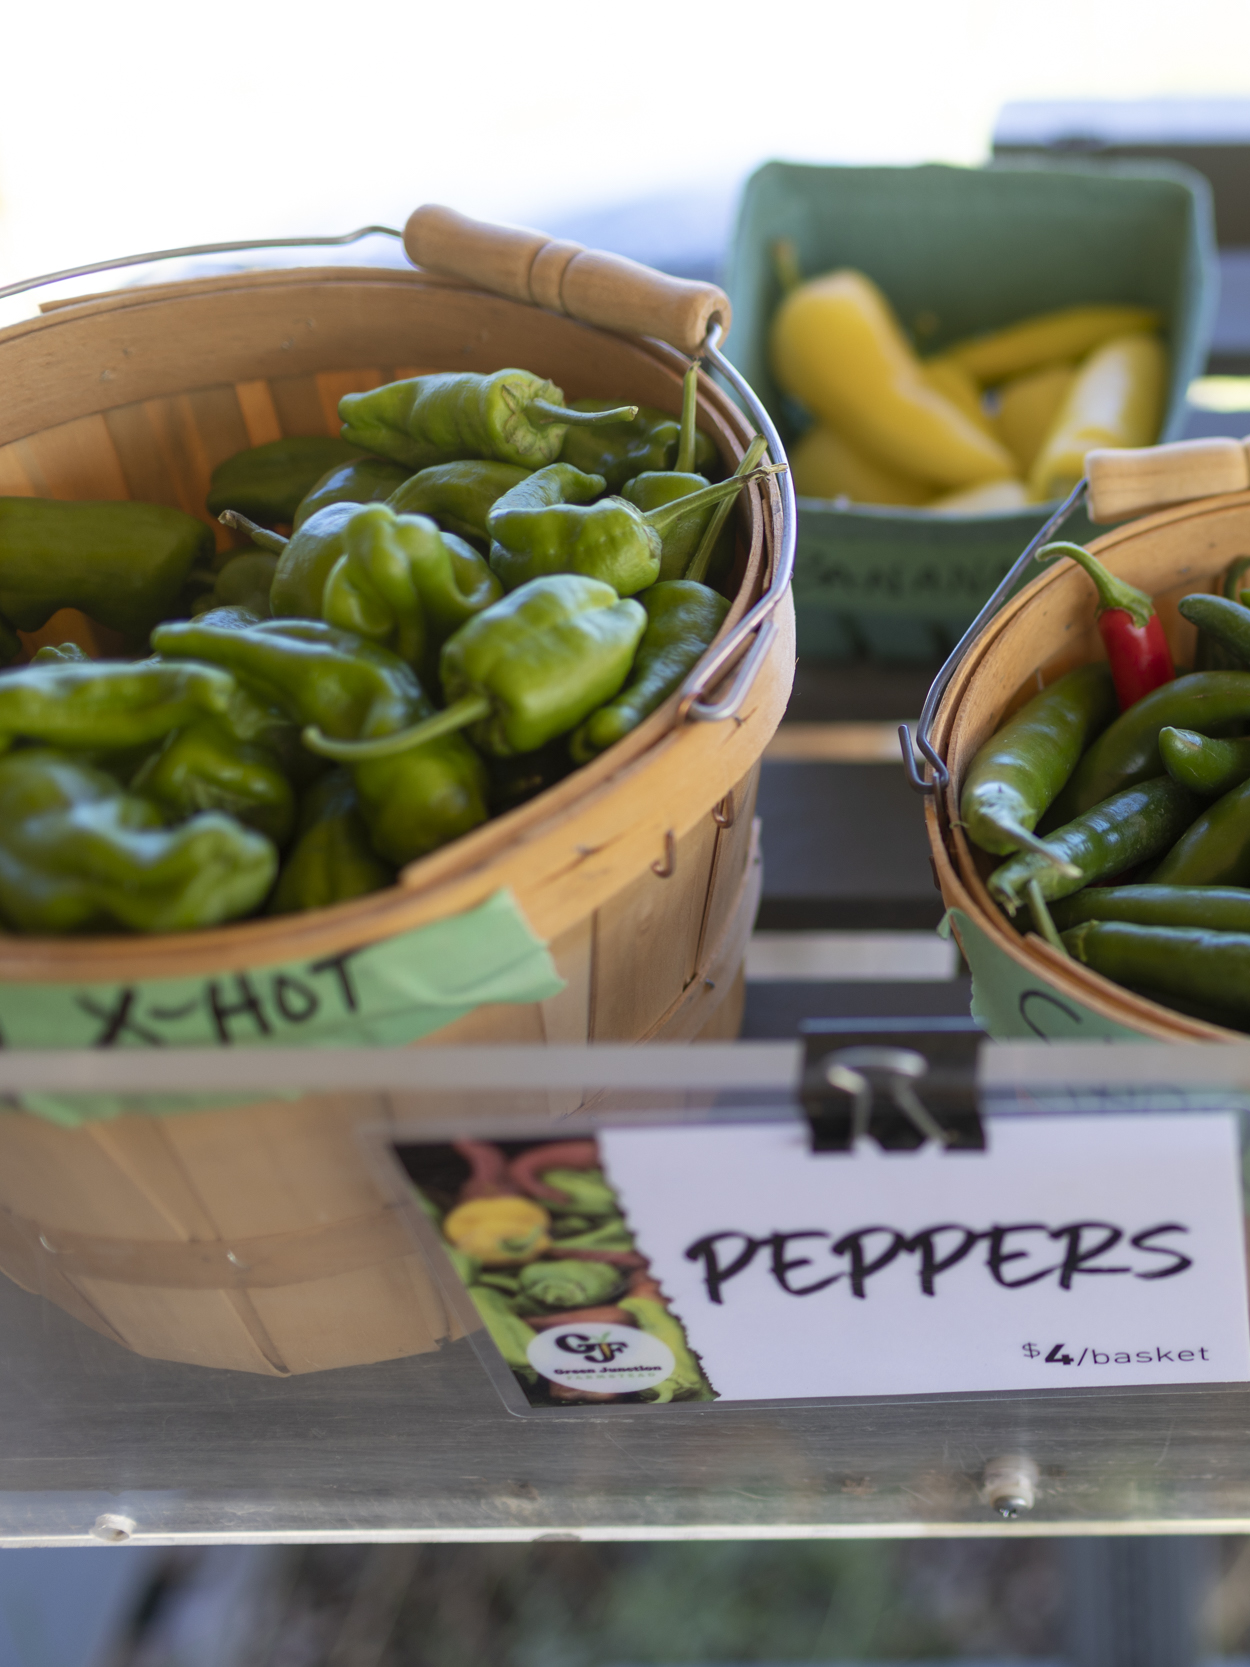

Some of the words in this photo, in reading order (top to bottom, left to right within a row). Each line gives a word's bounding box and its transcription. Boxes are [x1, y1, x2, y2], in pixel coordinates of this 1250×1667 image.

[73, 952, 358, 1048] X-HOT
[685, 1223, 1193, 1305] PEPPERS
[600, 1364, 663, 1373] Junction
[1021, 1342, 1210, 1367] $4/basket
